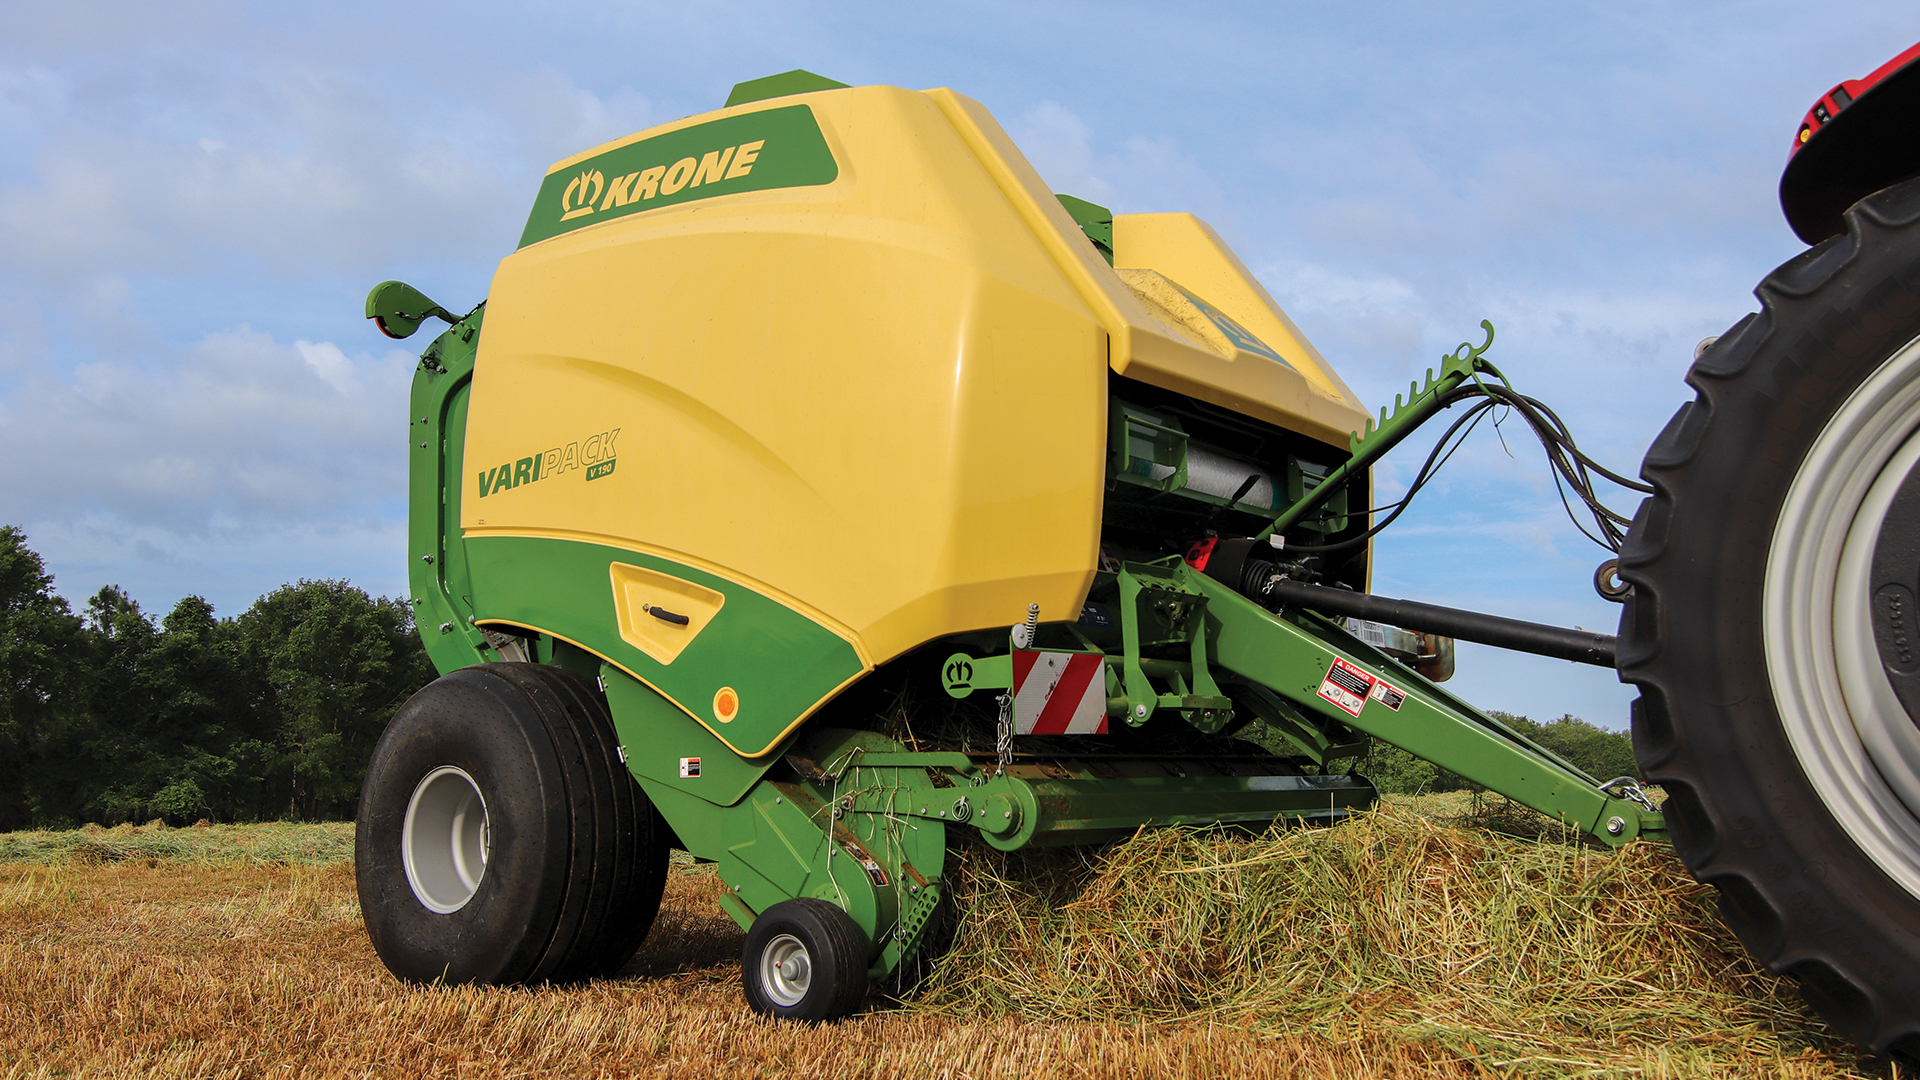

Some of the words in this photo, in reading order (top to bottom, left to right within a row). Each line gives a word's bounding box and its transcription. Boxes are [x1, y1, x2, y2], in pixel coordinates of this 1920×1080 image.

[599, 139, 765, 212] KRONE
[478, 428, 621, 498] VARIPACK
[590, 468, 597, 478] V
[598, 463, 612, 475] 190
[1345, 664, 1370, 682] DANGER
